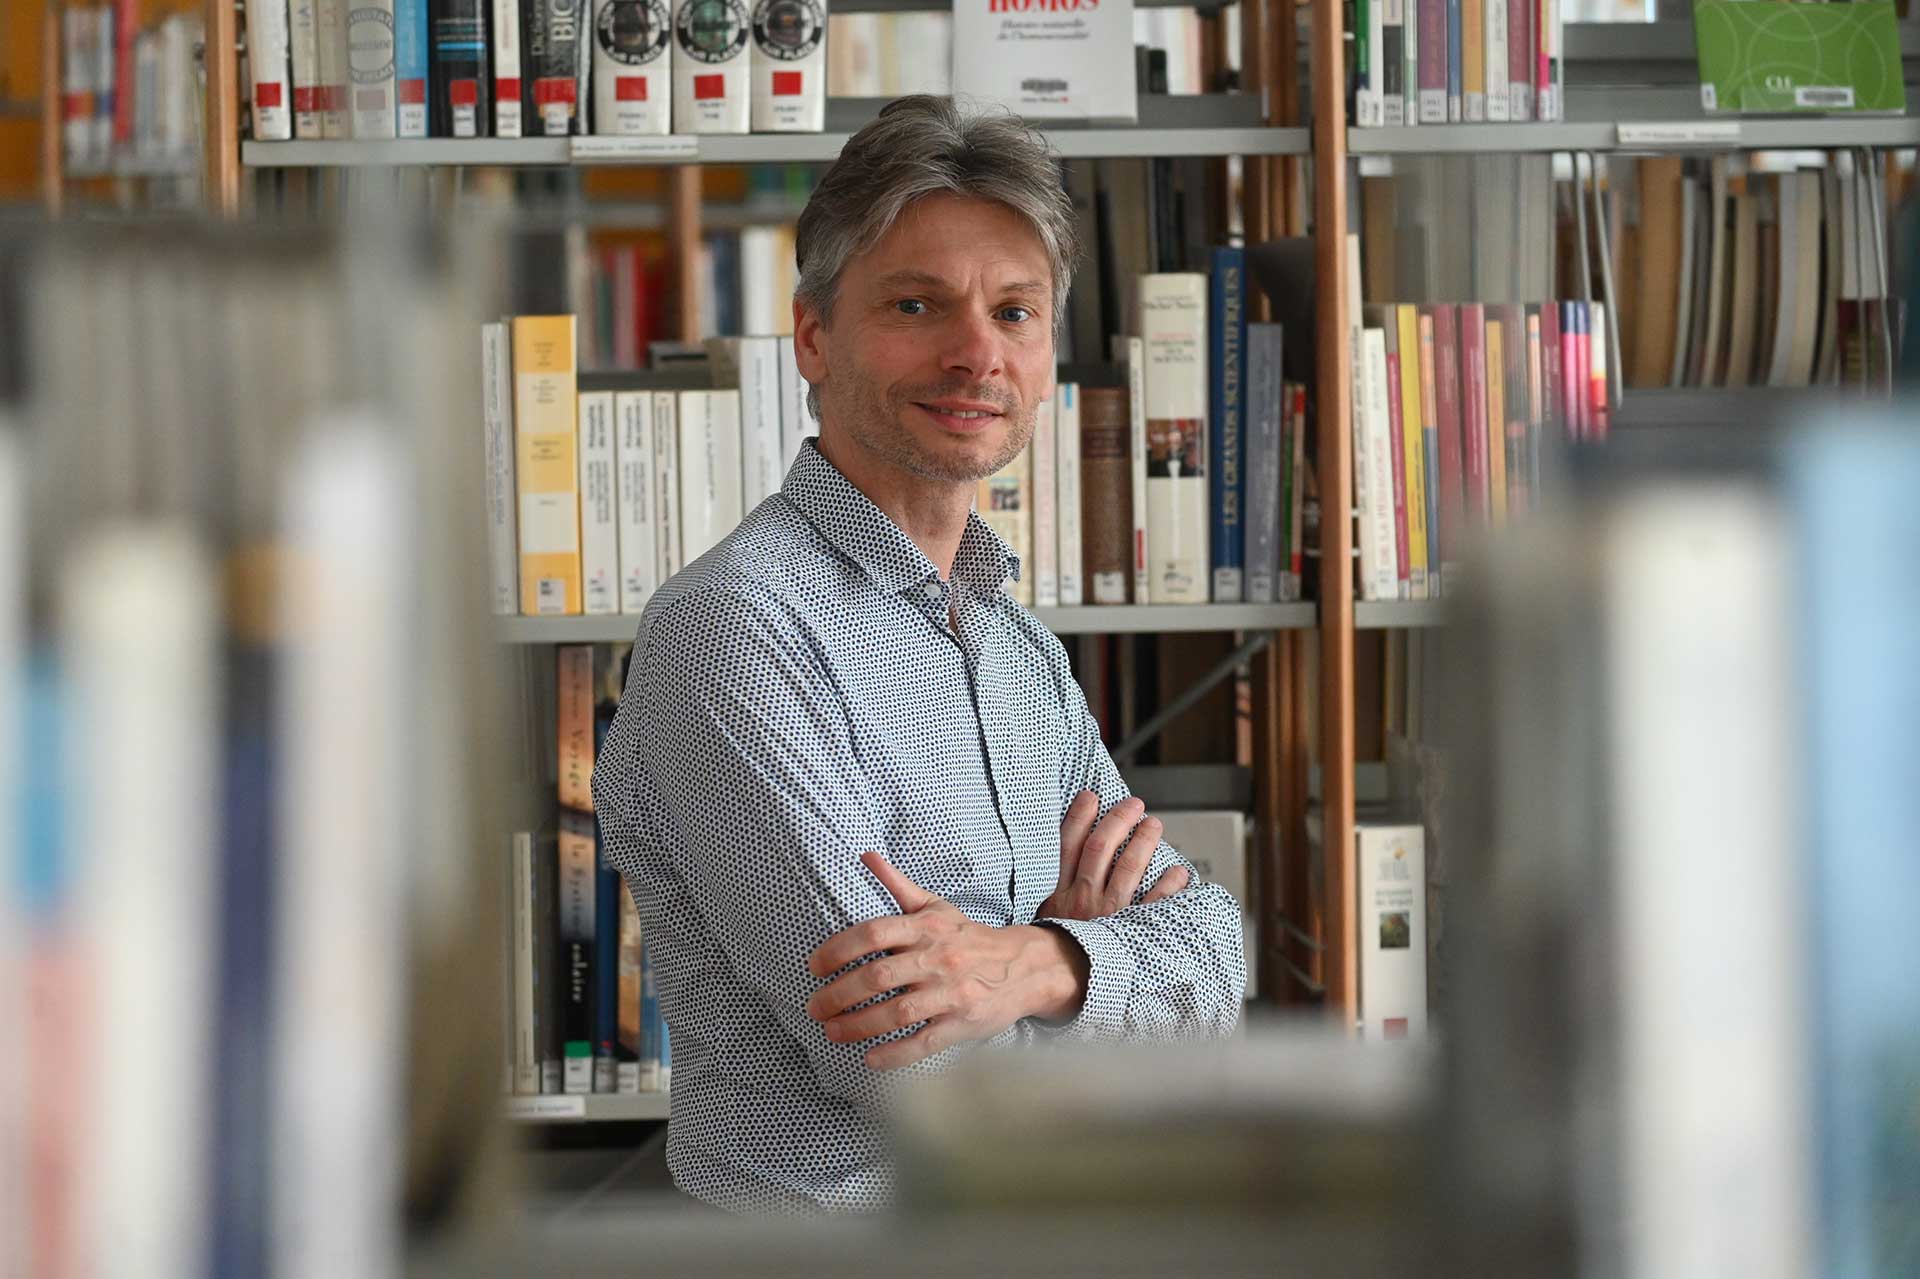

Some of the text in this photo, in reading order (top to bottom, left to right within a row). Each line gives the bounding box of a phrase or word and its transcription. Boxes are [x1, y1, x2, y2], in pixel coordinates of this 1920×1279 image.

[1223, 266, 1241, 525] LES GRANDS SCIENTIFIQUES
